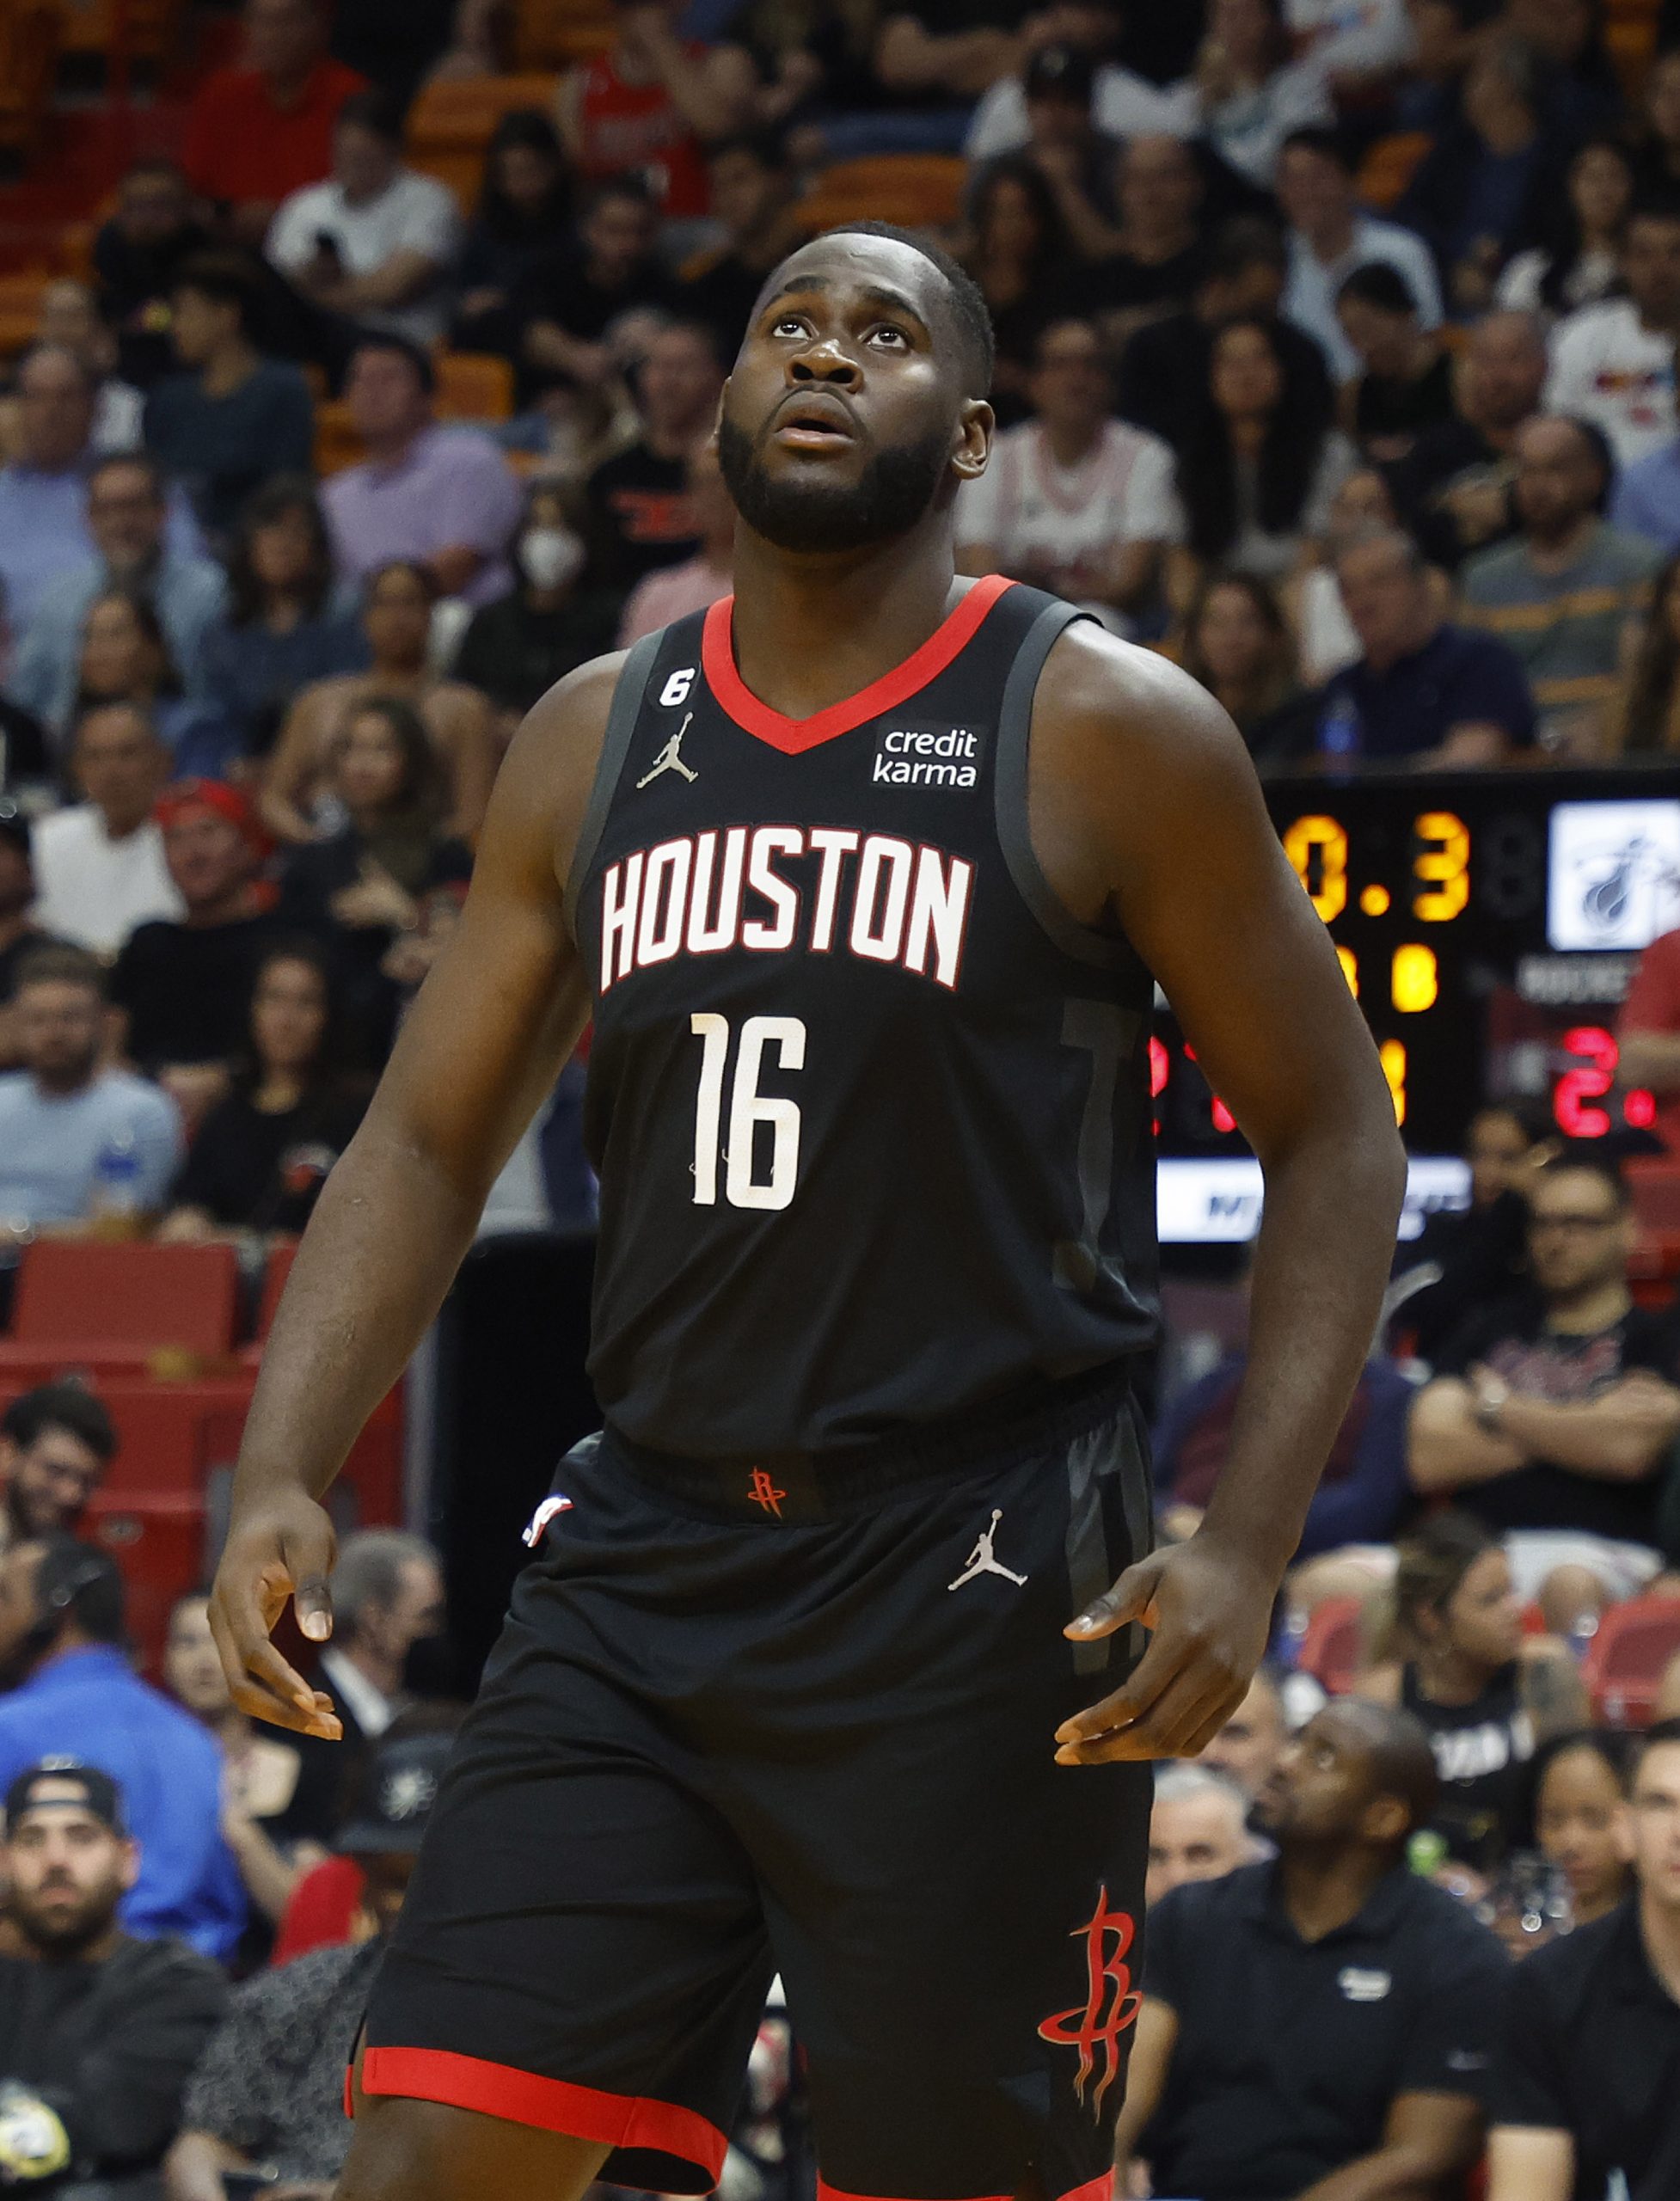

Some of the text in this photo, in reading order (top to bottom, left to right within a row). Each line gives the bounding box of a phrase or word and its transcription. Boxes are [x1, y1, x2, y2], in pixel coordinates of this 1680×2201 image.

[659, 667, 695, 707] 6
[884, 729, 978, 757] credit
[873, 754, 977, 787] karma
[600, 825, 972, 994] HOUSTON
[690, 1013, 806, 1211] 16
